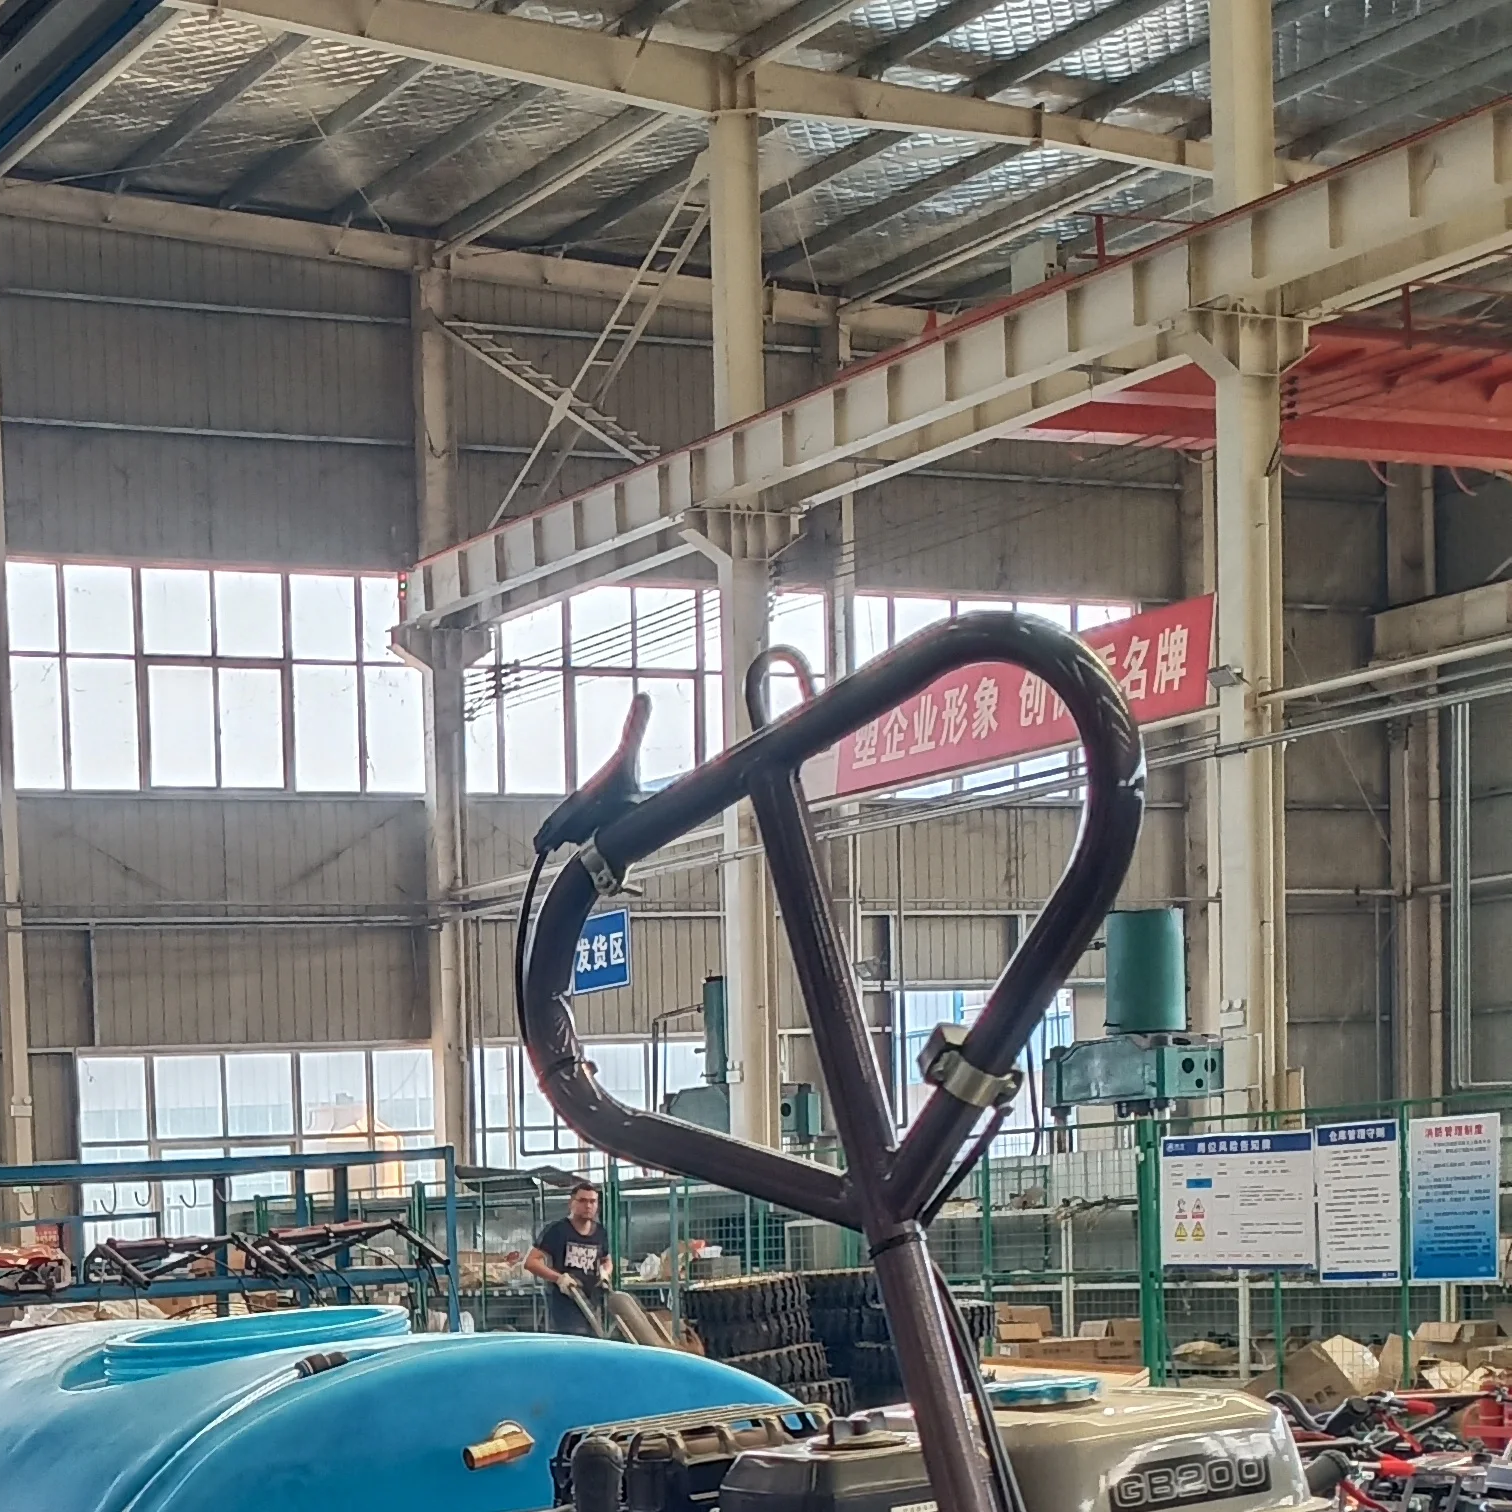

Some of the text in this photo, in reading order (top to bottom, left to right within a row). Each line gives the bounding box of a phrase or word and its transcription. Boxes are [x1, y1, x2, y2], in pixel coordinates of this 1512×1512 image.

[1019, 624, 1189, 727] 创名牌
[576, 931, 625, 974] 发货区
[564, 1255, 595, 1275] PARK
[566, 1244, 598, 1259] LINKIN
[1114, 1457, 1267, 1508] GB200
